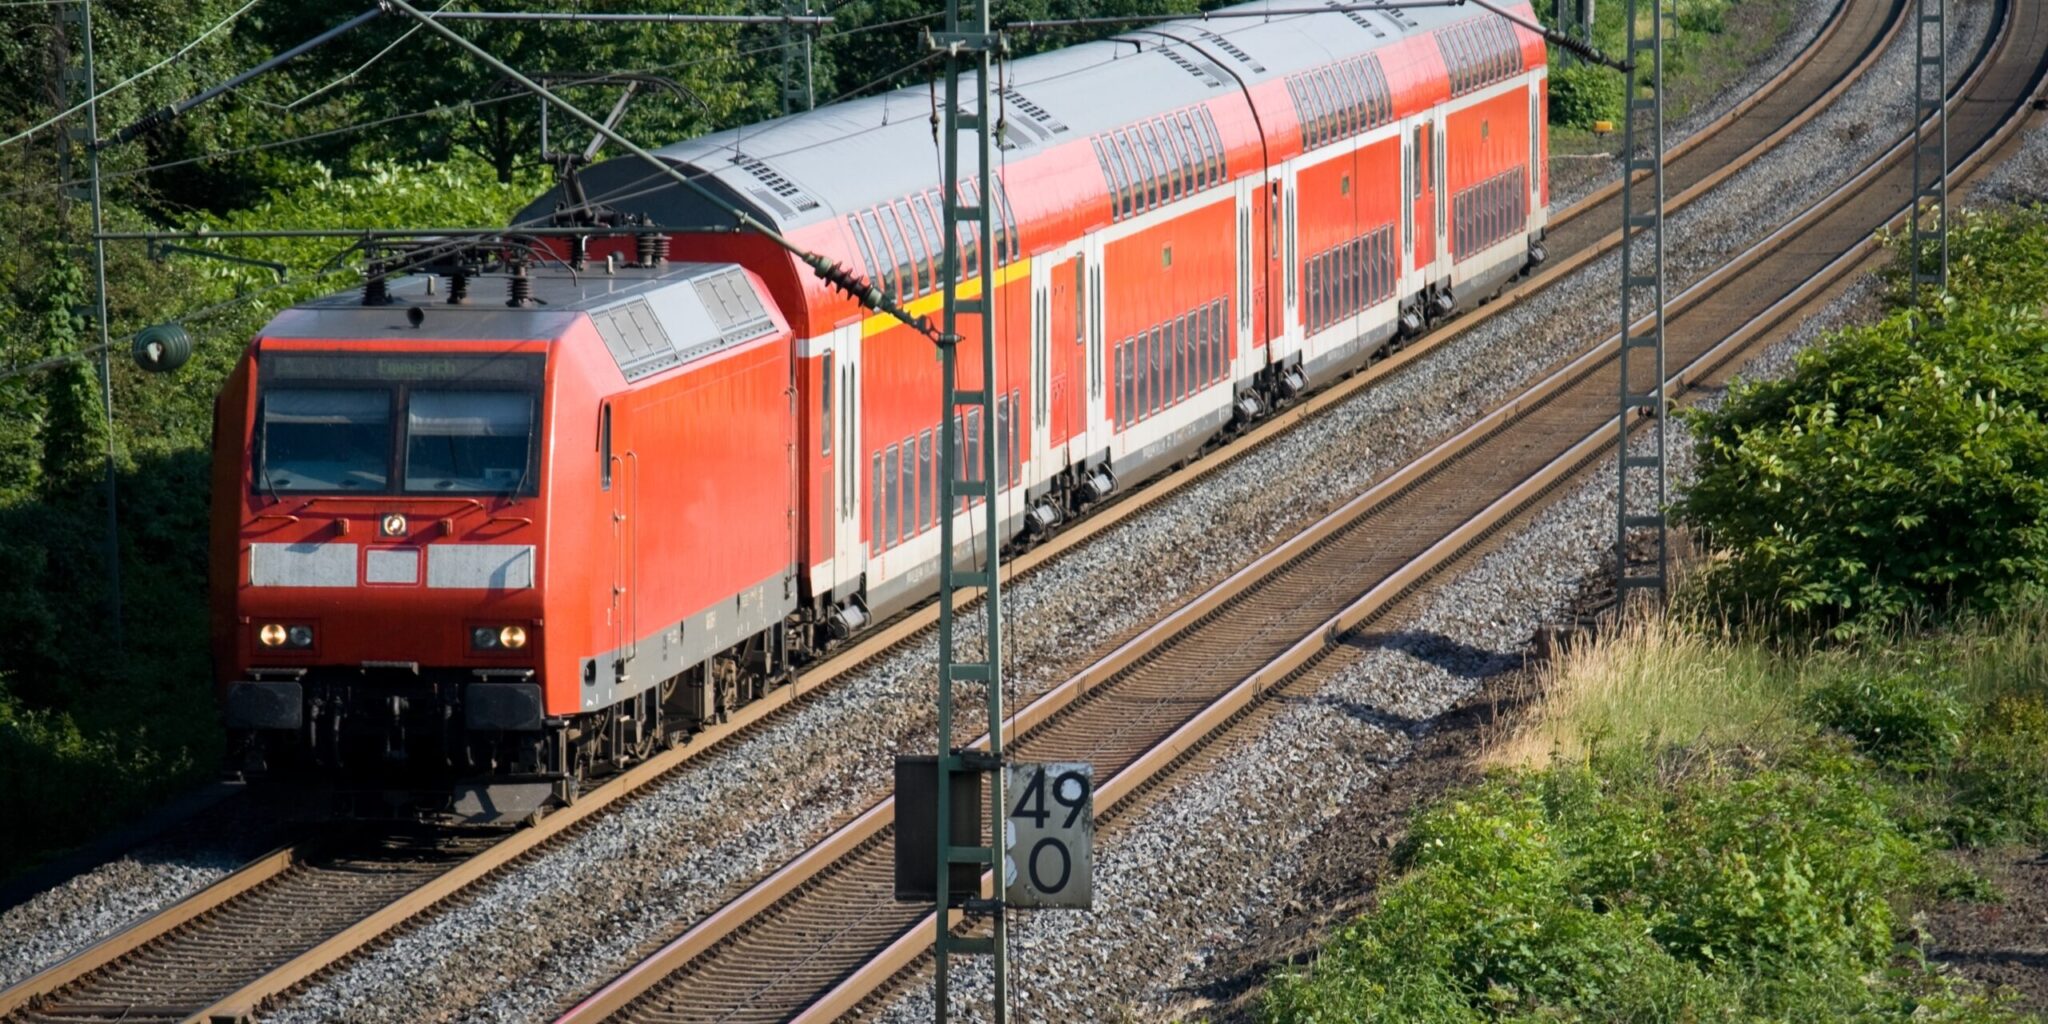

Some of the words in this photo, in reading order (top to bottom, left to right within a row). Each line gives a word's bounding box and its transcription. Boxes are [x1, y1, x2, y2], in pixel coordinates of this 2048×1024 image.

[378, 358, 456, 376] Emmerich
[1011, 767, 1090, 829] 49
[1028, 837, 1072, 894] 0
